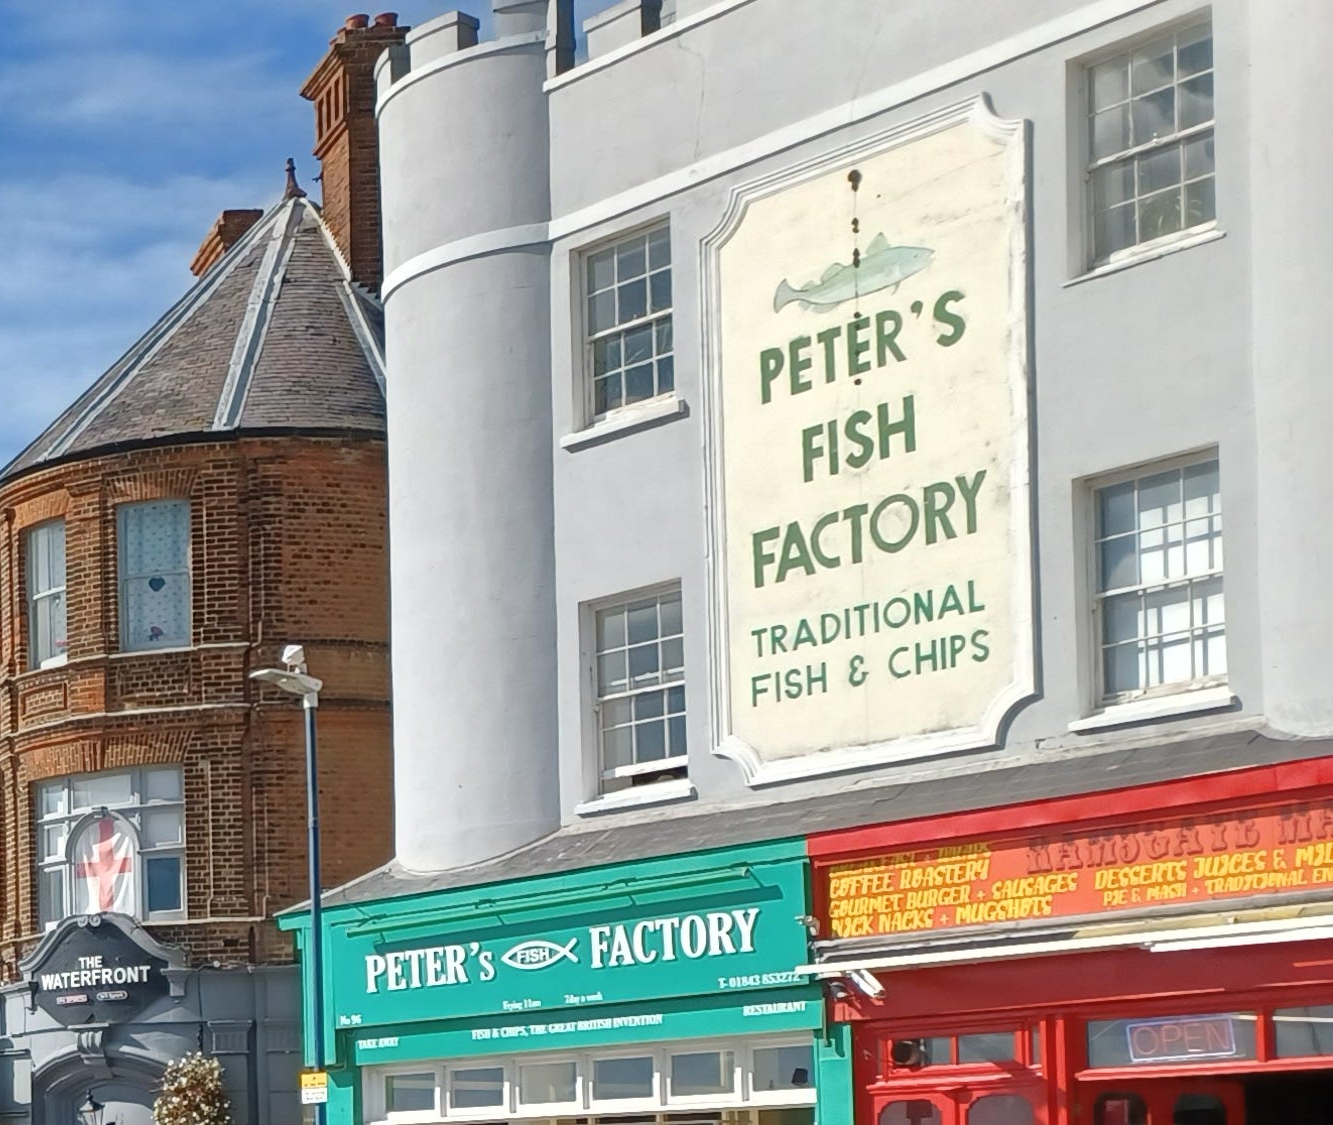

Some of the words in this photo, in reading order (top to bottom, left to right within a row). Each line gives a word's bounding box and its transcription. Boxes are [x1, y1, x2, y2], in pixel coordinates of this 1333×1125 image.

[760, 289, 967, 405] PETER'S
[801, 394, 917, 484] FISH
[751, 468, 988, 589] FACTORY
[750, 578, 986, 659] TRADITIONAL
[750, 658, 828, 709] FISH
[849, 654, 870, 687] &
[888, 628, 990, 679] CHIPS
[829, 871, 895, 899] COFFEE
[899, 858, 990, 890] ROASTERY
[1094, 860, 1188, 891] DESSERTS
[1273, 848, 1287, 870] &
[829, 894, 904, 918] GOURMET
[906, 885, 972, 911] BURGER
[991, 872, 1078, 900] SAUSAGES
[1146, 882, 1188, 901] MASH
[878, 909, 934, 933] NACKS
[955, 896, 1053, 924] MUGSHOTS
[516, 947, 550, 965] FISH
[588, 908, 760, 970] FACTORY
[41, 965, 151, 991] WATERFRONT
[78, 955, 104, 969] THE
[529, 1023, 548, 1035] THE
[613, 1014, 663, 1029] INVENTION
[742, 1000, 806, 1017] RESTAURANT
[1132, 1022, 1231, 1055] OPEN
